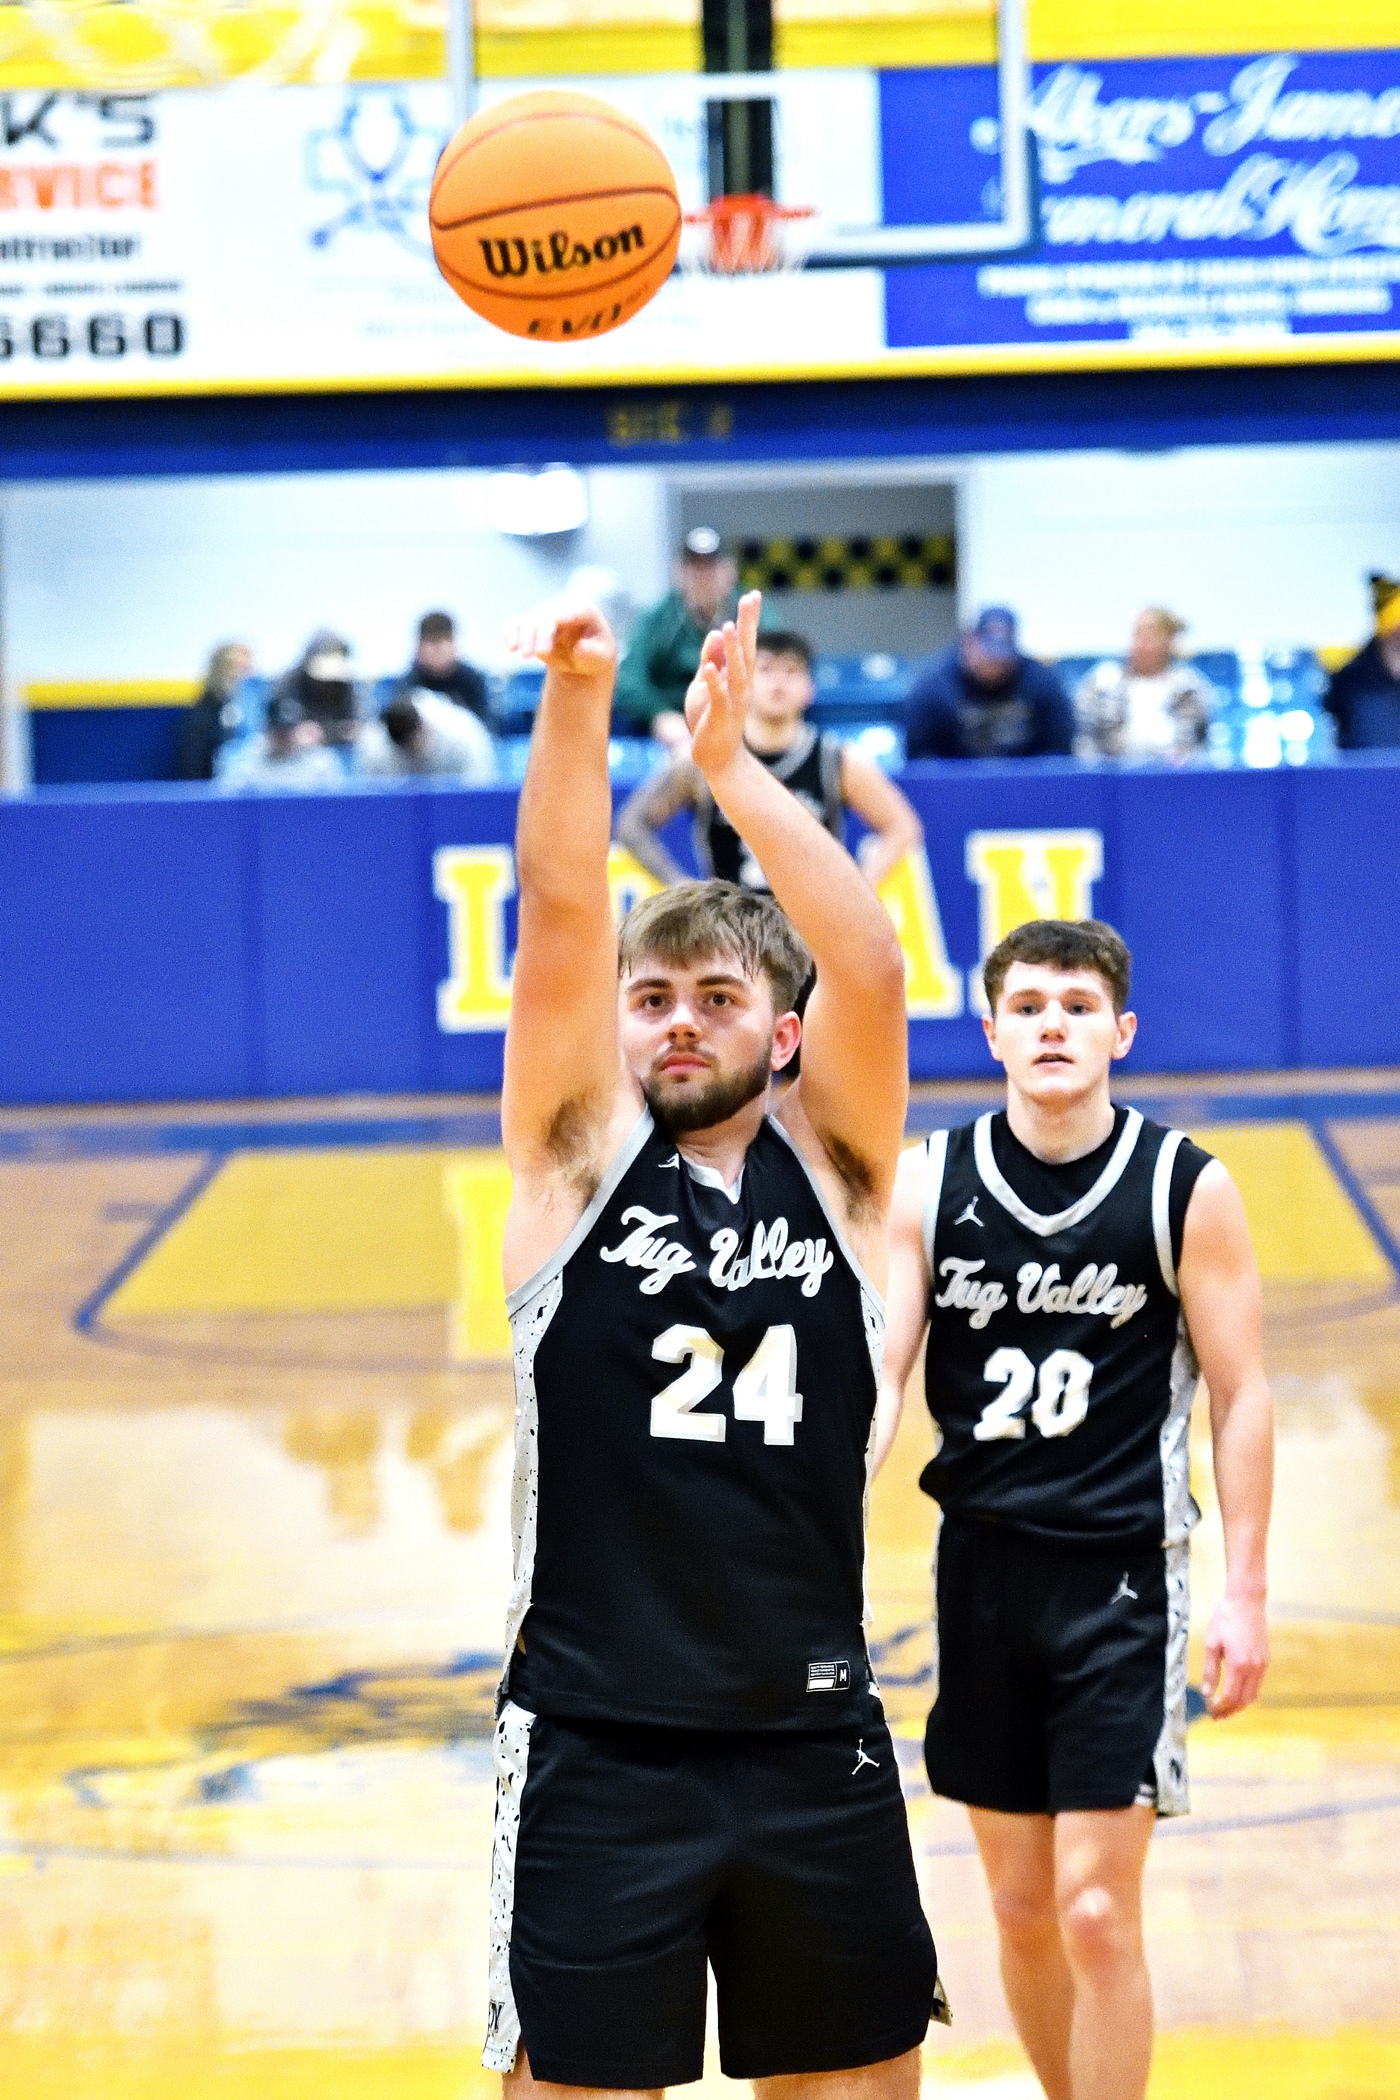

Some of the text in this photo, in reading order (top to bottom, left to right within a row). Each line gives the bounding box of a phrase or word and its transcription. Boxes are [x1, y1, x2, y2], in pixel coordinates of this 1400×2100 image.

[479, 224, 645, 278] Wilson
[433, 828, 1105, 1034] LAN
[600, 1205, 834, 1298] Tug Valley
[935, 1256, 1148, 1330] Tug Valley
[650, 1323, 804, 1446] 24
[973, 1347, 1095, 1441] 20
